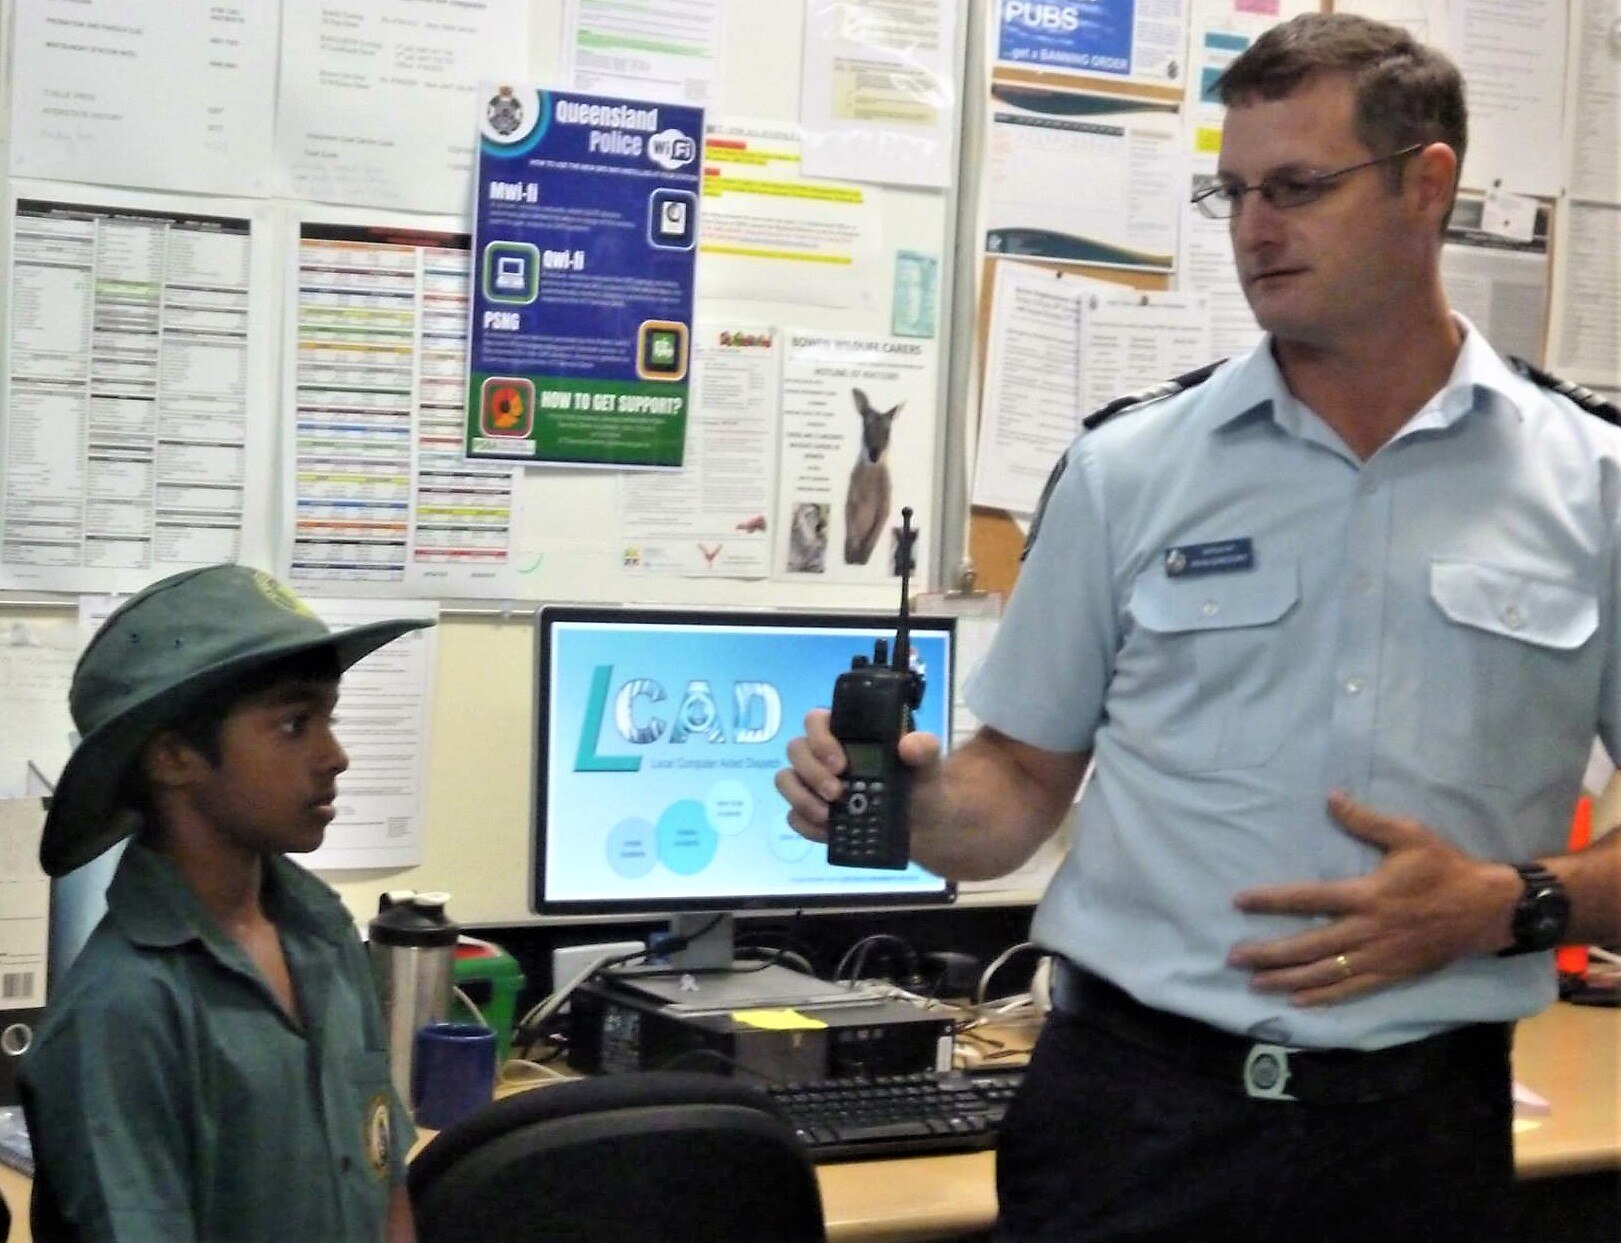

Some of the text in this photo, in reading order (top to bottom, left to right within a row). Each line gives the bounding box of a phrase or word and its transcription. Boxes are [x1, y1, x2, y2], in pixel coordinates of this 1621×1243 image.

[1005, 0, 1079, 31] PUBS
[556, 100, 658, 131] Queensland
[589, 130, 642, 156] Police
[540, 390, 683, 415] HOW TO GET SUPPORT?
